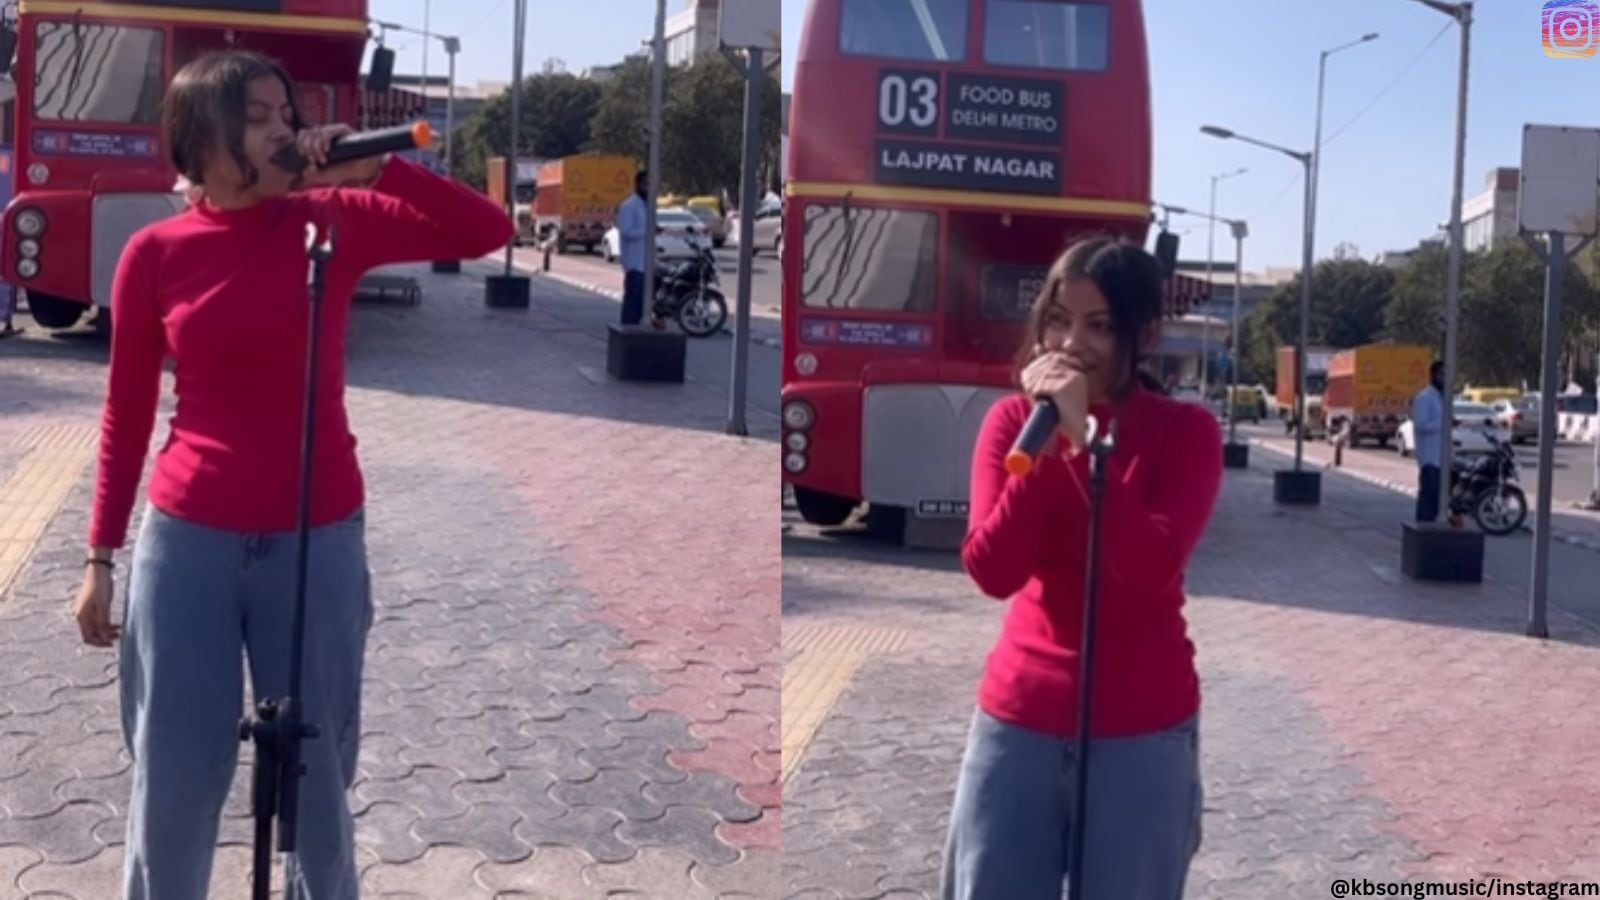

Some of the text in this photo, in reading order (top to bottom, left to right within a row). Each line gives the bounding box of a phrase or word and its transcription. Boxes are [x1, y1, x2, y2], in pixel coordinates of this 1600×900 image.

[880, 75, 938, 127] 03
[960, 85, 1052, 109] FOOD BUS
[951, 109, 1057, 133] DELHI METRO
[882, 149, 1055, 179] LAJPAT NAGAR
